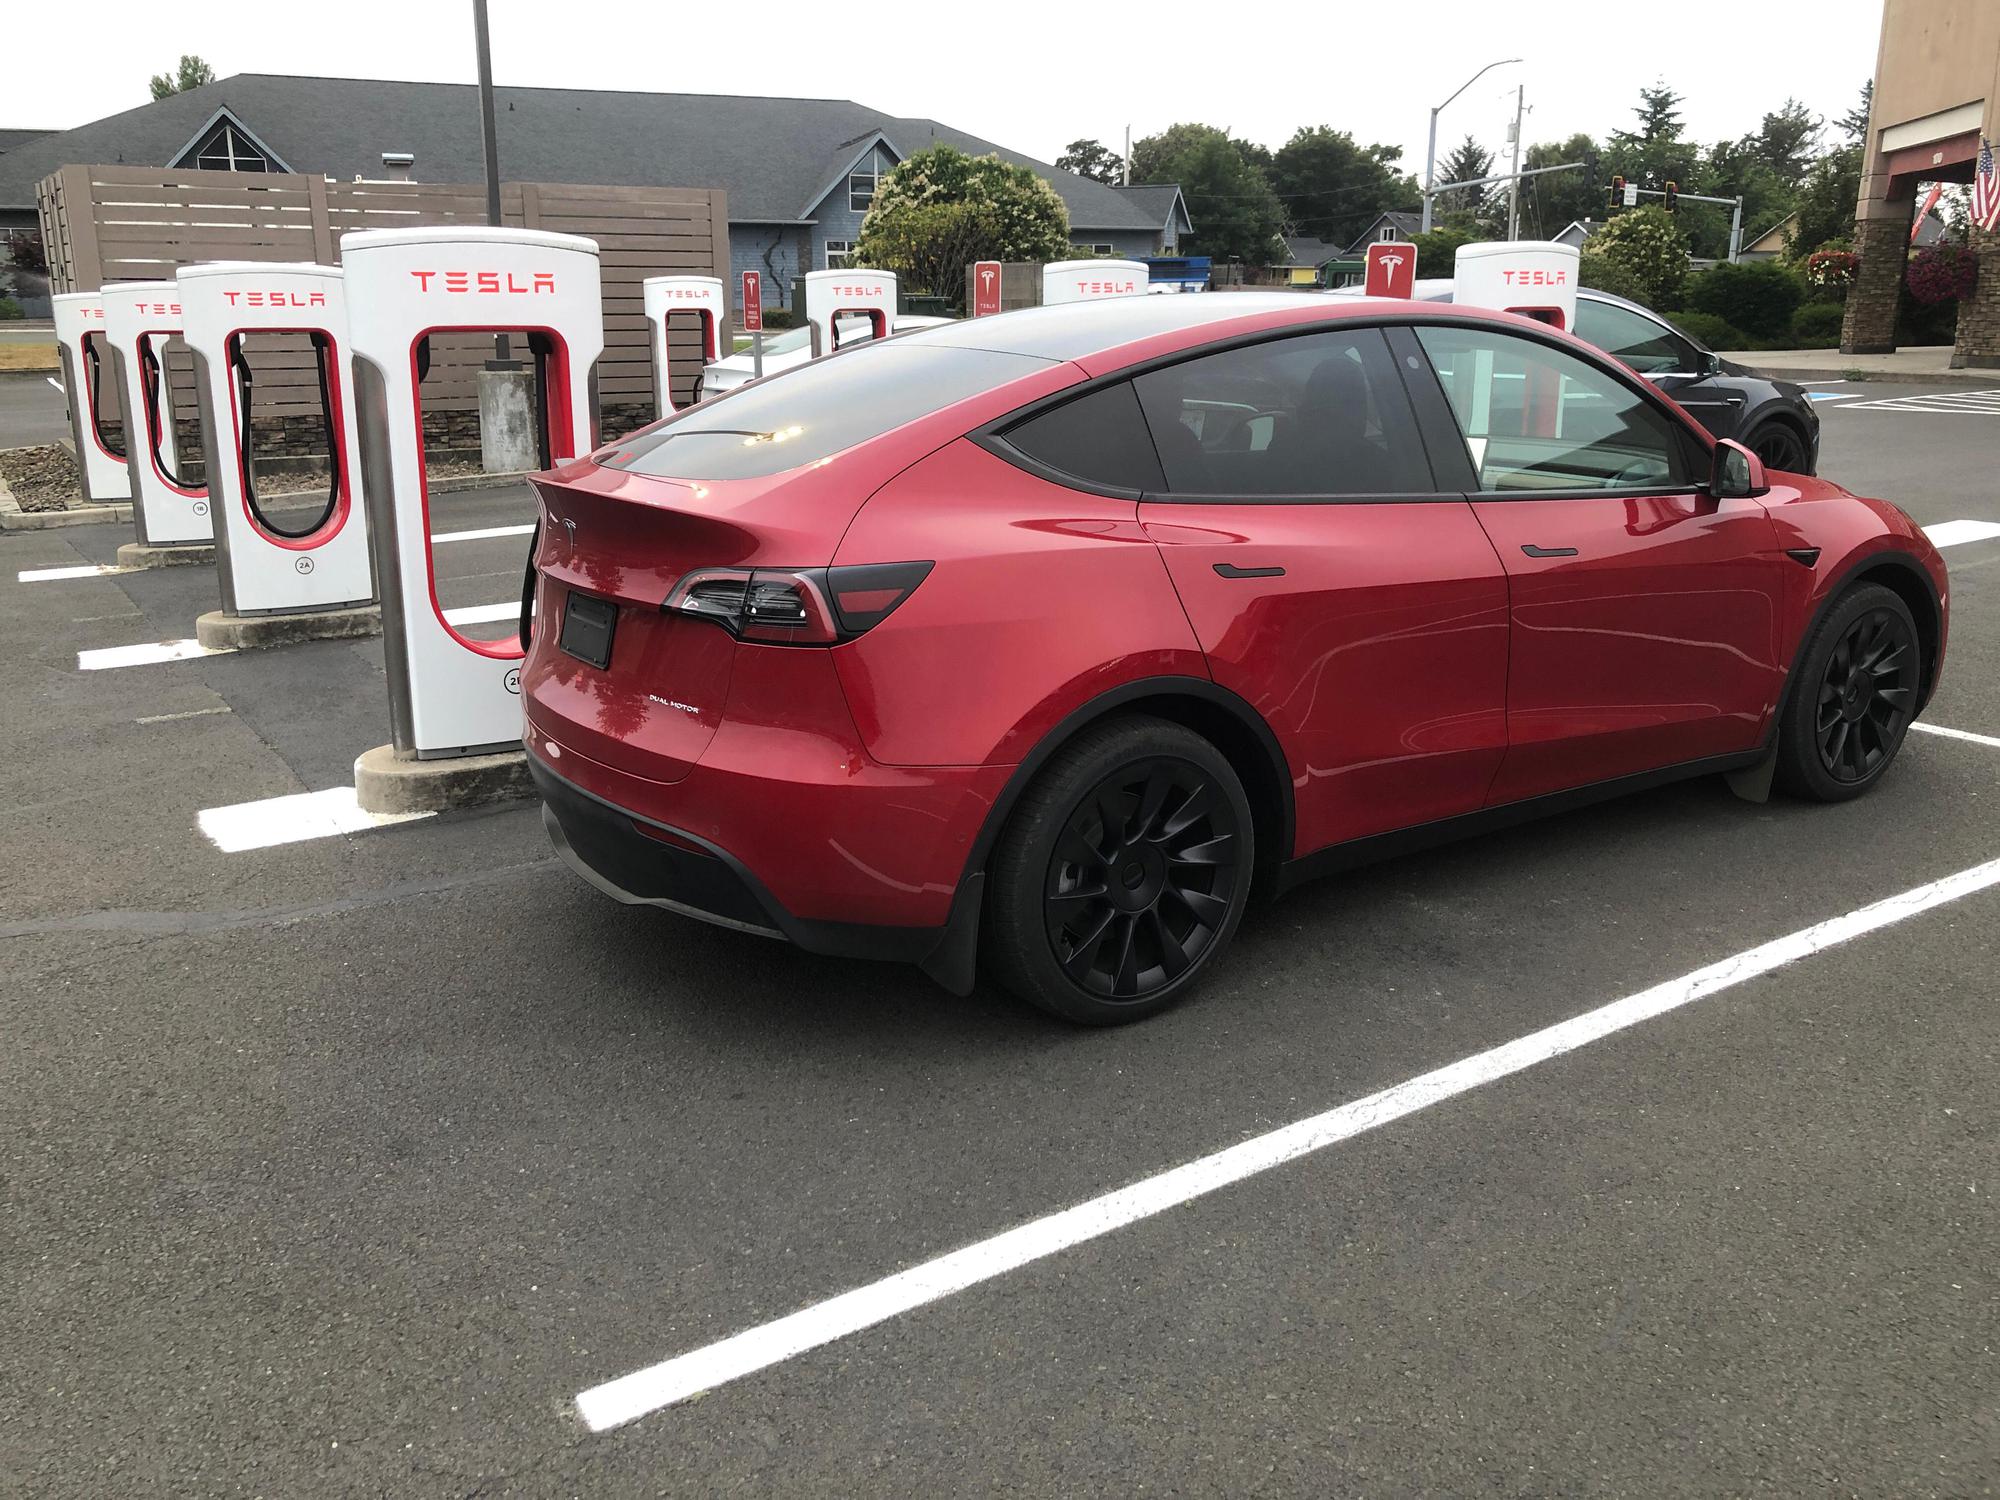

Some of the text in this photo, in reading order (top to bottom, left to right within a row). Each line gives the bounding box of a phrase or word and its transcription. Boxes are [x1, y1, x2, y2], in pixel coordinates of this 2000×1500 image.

[410, 270, 555, 295] TESLA
[1503, 270, 1567, 286] TESLA
[665, 289, 710, 298] TESLA
[832, 286, 883, 297] TESLA
[1078, 281, 1134, 294] TESLA
[223, 291, 326, 307] TESLA
[134, 303, 182, 315] TES
[649, 694, 699, 714] DUAL MOTOR
